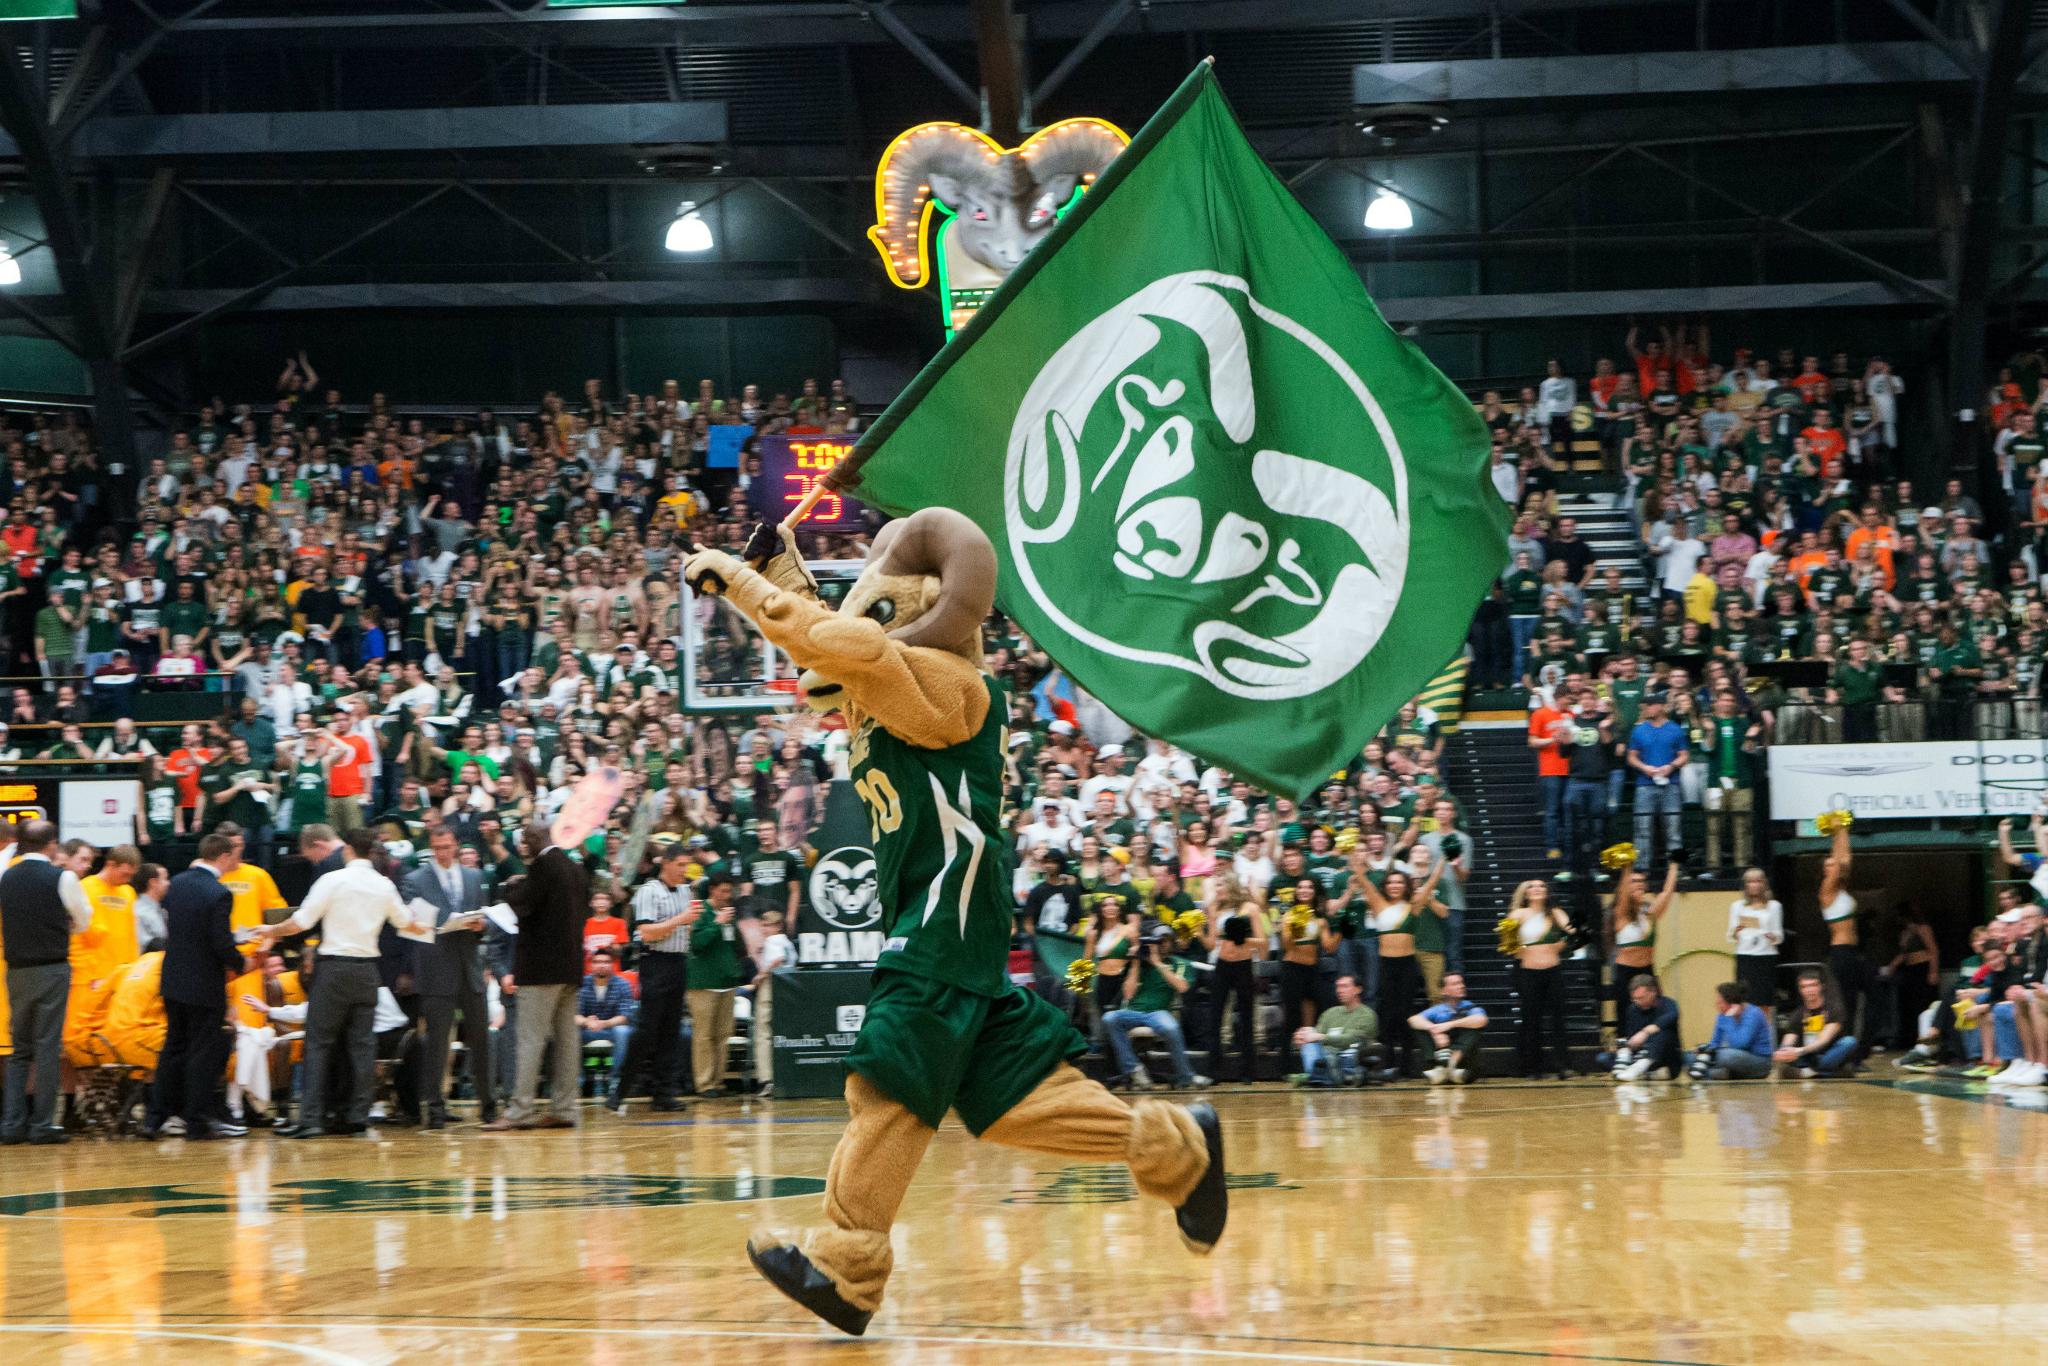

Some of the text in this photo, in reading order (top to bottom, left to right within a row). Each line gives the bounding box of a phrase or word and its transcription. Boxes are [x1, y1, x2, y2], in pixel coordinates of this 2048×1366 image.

[784, 473, 843, 523] 35
[1951, 754, 2048, 766] DOD
[798, 931, 885, 963] RAM
